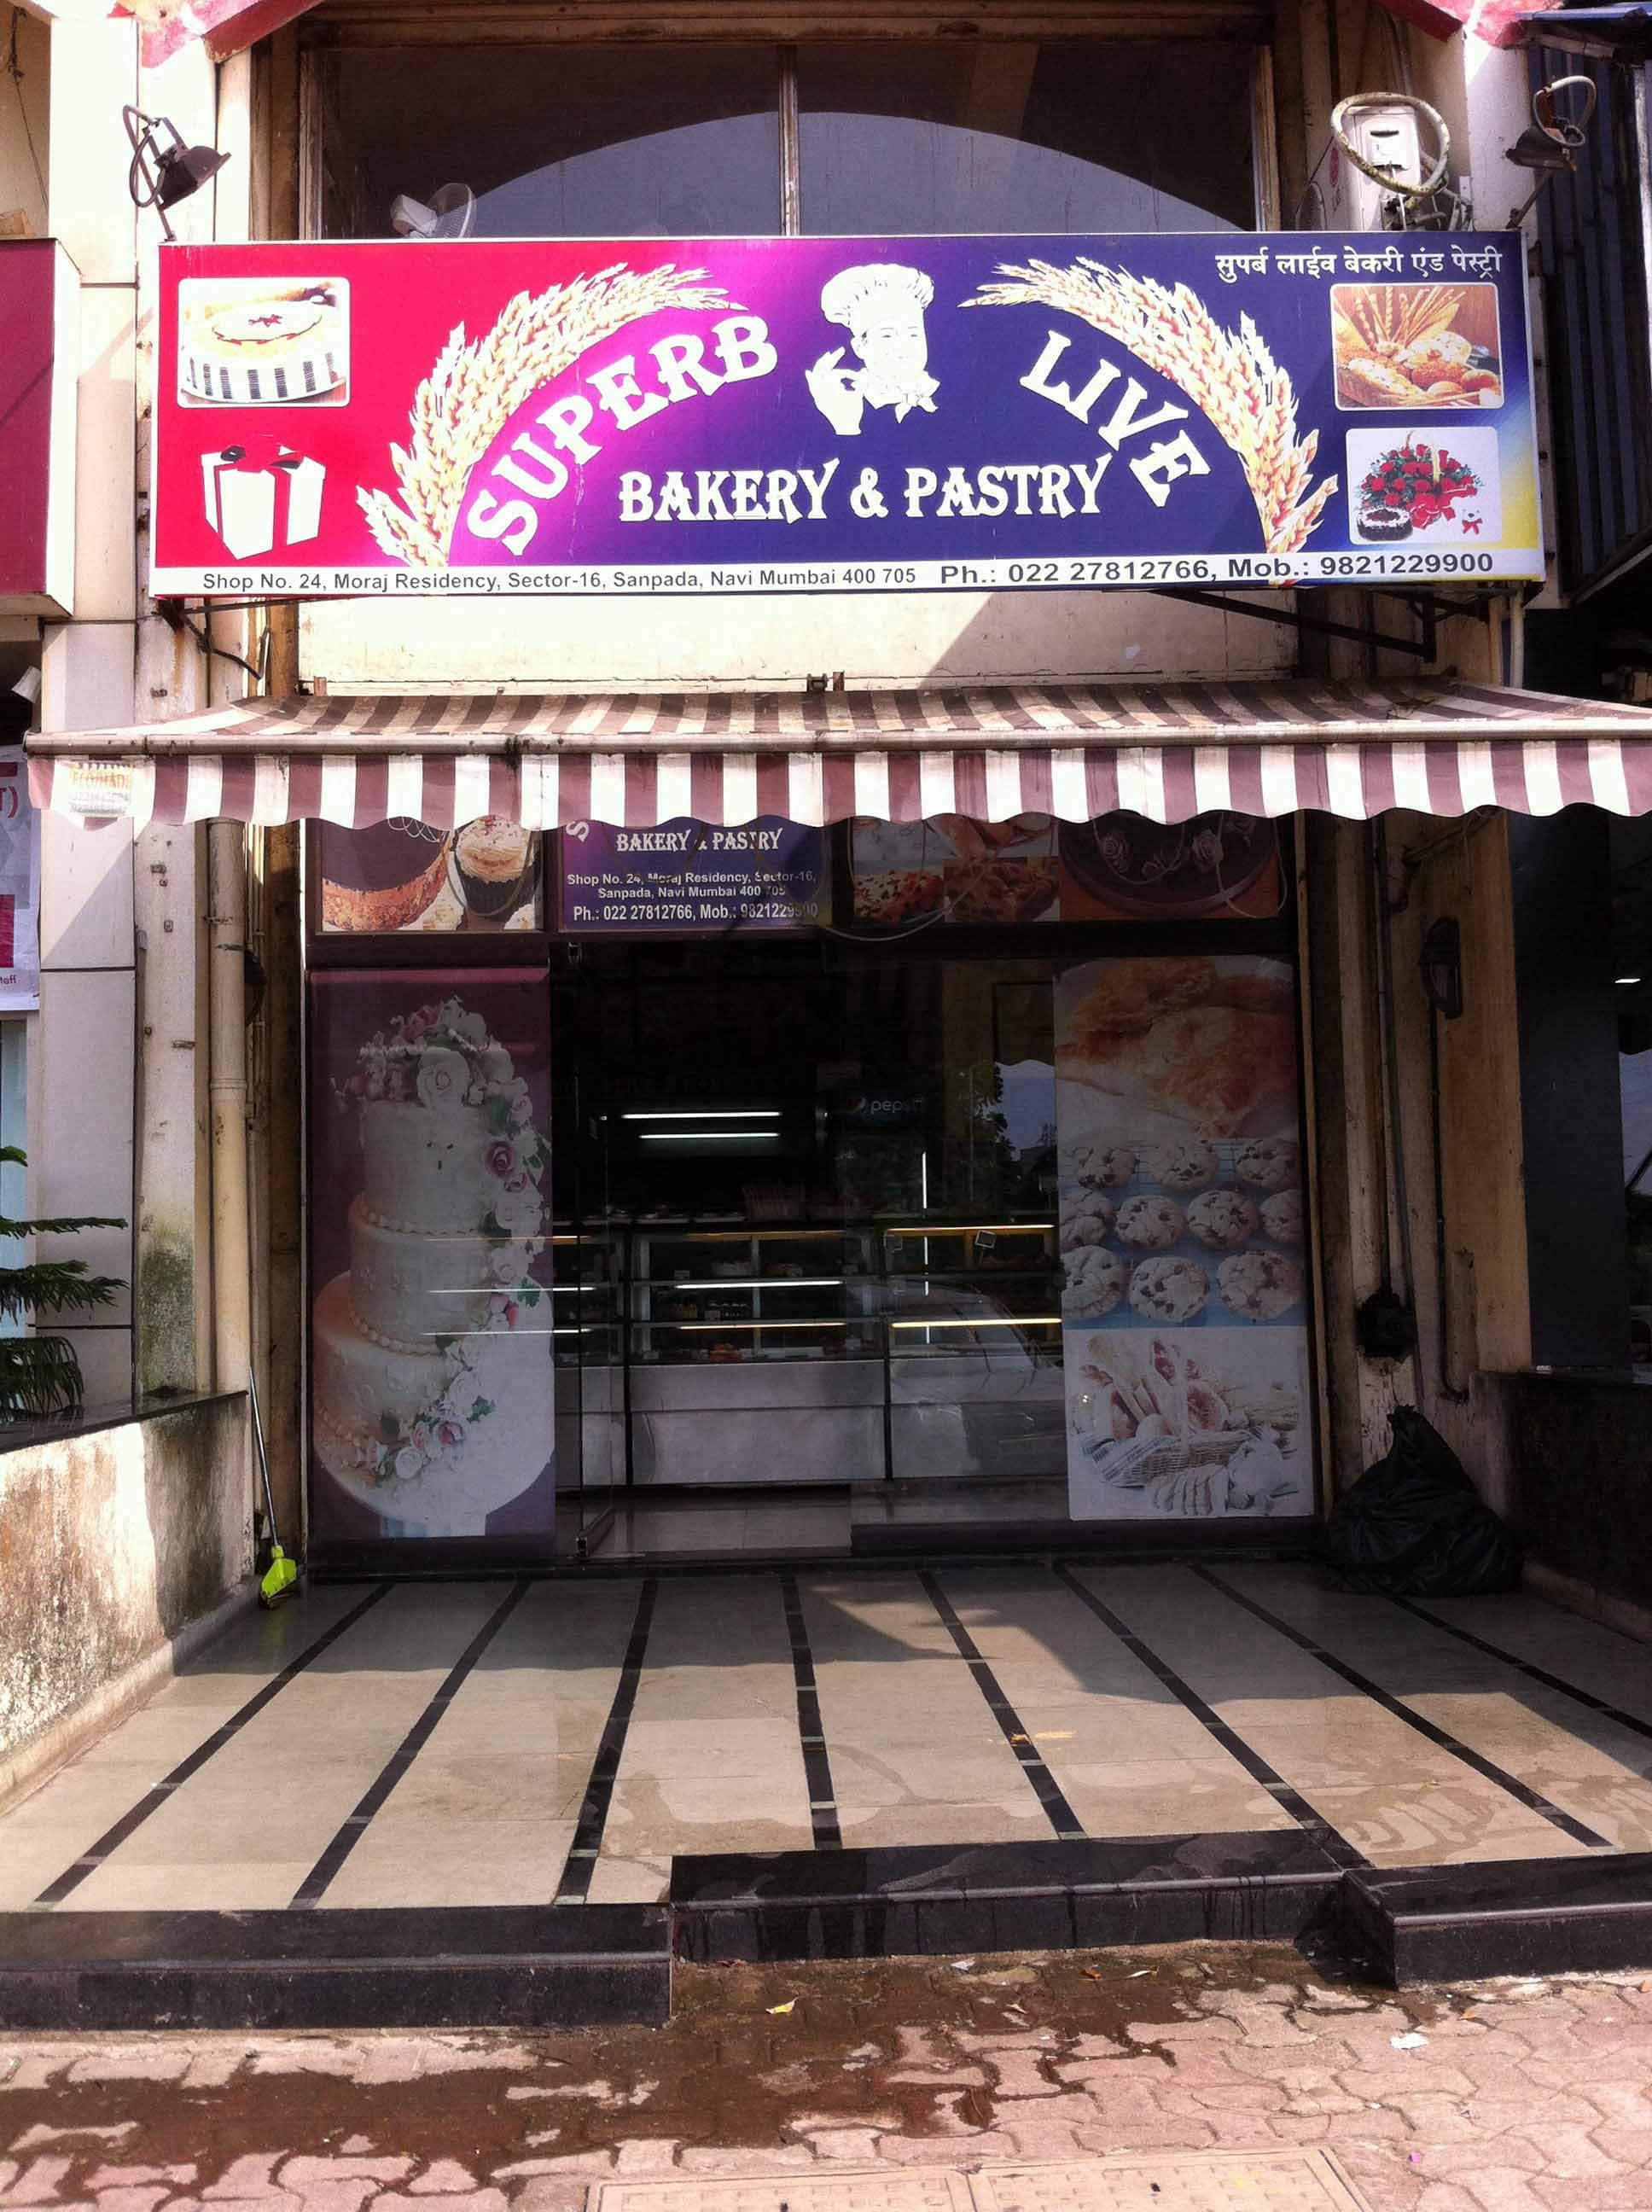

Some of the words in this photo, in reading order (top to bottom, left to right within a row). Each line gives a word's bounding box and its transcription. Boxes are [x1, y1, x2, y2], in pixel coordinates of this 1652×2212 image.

[1215, 247, 1269, 283] सुपर्ब
[1275, 246, 1337, 279] लाईव
[1343, 246, 1405, 274] बेकरी
[1411, 247, 1444, 277] एंड
[1451, 245, 1503, 279] पेस्ट्री
[467, 316, 778, 556] SUPERB
[1019, 329, 1212, 508] LIVE
[619, 457, 840, 524] BAKERY
[850, 467, 888, 519] &
[904, 453, 1113, 519] PASTRY
[203, 573, 253, 592] Shop
[261, 573, 292, 589] No.
[300, 573, 327, 591] 24,
[334, 573, 388, 593] Moraj
[396, 572, 501, 591] Residency,
[508, 570, 606, 591] Sector-16,
[614, 571, 704, 591] Sanpada,
[711, 569, 753, 586] Navi
[759, 568, 836, 585] Mumbai
[842, 568, 875, 584] 400
[883, 568, 916, 583] 705
[940, 565, 996, 584] Ph.:
[1009, 563, 1059, 582] 022
[1070, 560, 1217, 582] 27812766,
[1228, 558, 1309, 577] Mob.:
[1320, 554, 1493, 575] 9821229900
[616, 829, 691, 852] BAKERY
[567, 874, 599, 887] Shop
[602, 874, 623, 885] No.
[626, 874, 644, 886] 24,
[685, 872, 752, 885] Residency,
[598, 888, 654, 900] Sanpada,
[658, 887, 684, 898] Navi
[689, 886, 736, 897] Mumbai
[740, 886, 761, 896] 400
[573, 906, 599, 921] Ph.:
[603, 905, 627, 920] 022
[631, 905, 696, 921] 27812766,
[700, 904, 736, 919] Mob.:
